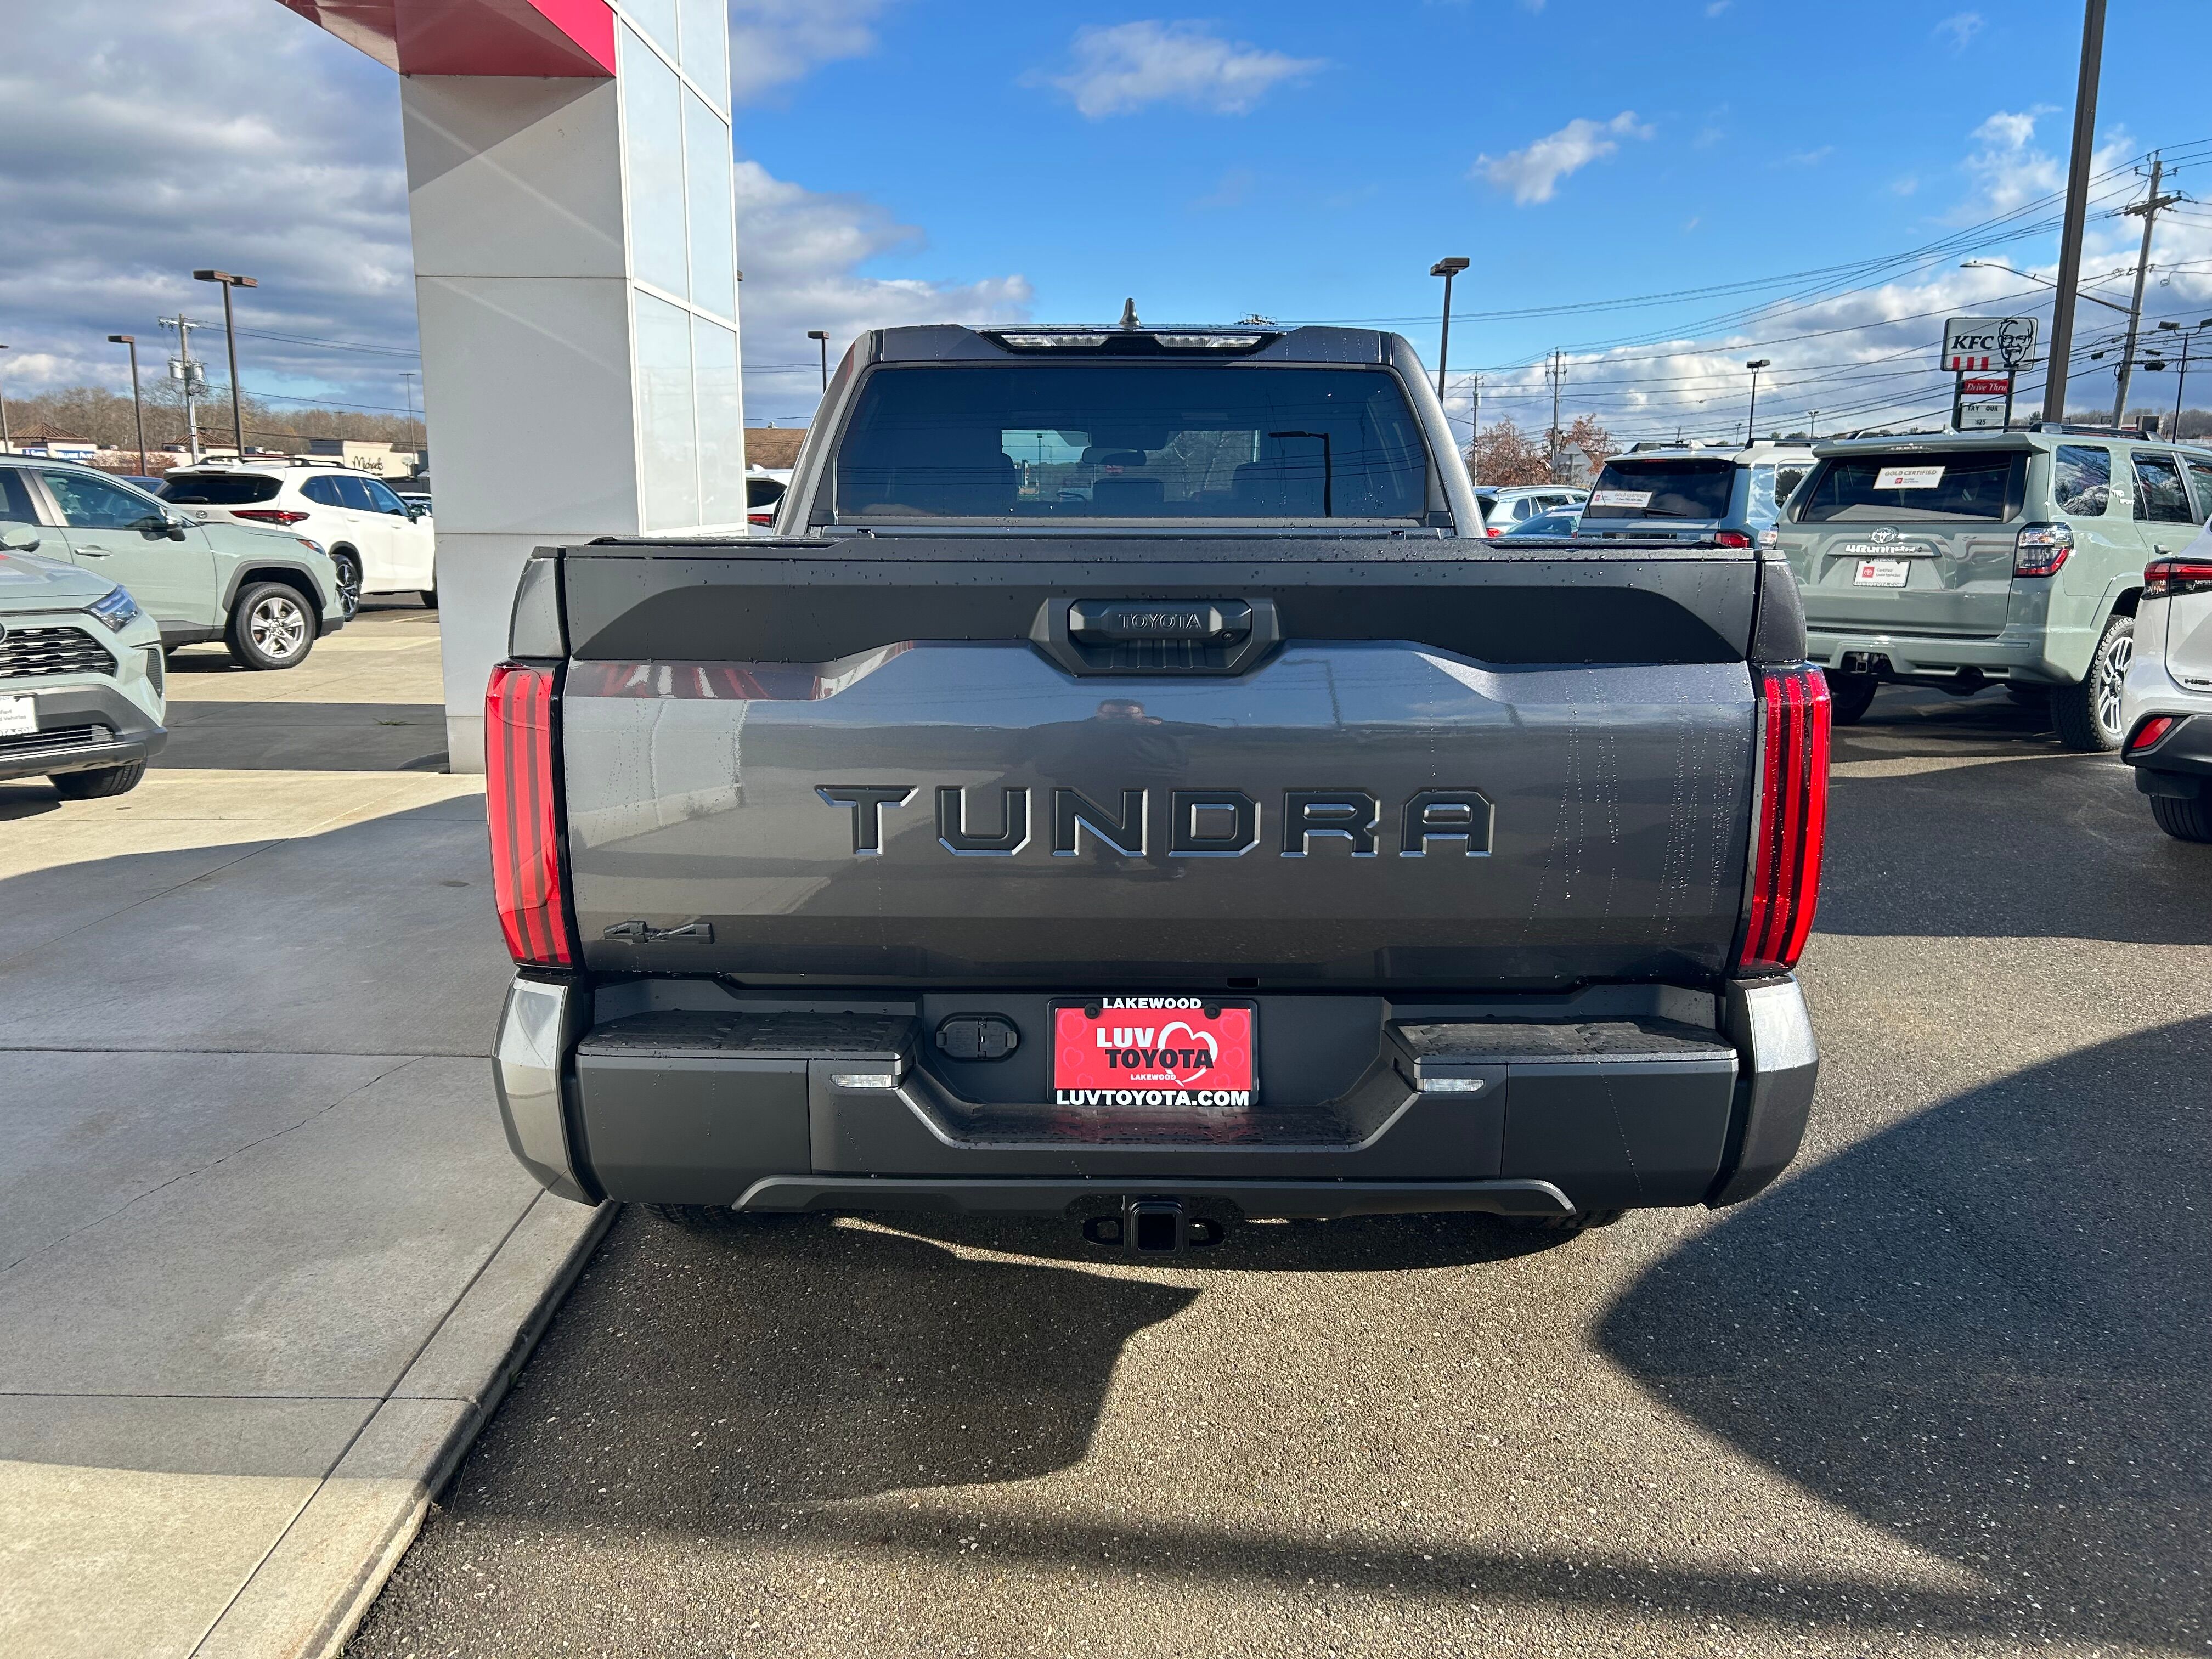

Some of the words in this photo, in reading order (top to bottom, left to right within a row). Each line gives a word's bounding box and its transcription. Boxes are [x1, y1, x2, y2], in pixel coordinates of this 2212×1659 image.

[1951, 335, 1994, 349] KFC
[1966, 383, 1987, 391] Drive
[1989, 383, 2007, 391] Thru
[1119, 613, 1202, 629] TOYOTA
[814, 786, 1496, 857] TUNDRA
[1103, 998, 1201, 1009] LAKEWOOD
[1097, 1027, 1155, 1048] LUV
[1105, 1049, 1214, 1069] TOYOTA
[1057, 1090, 1250, 1106] LUVTOYOTA.COM
